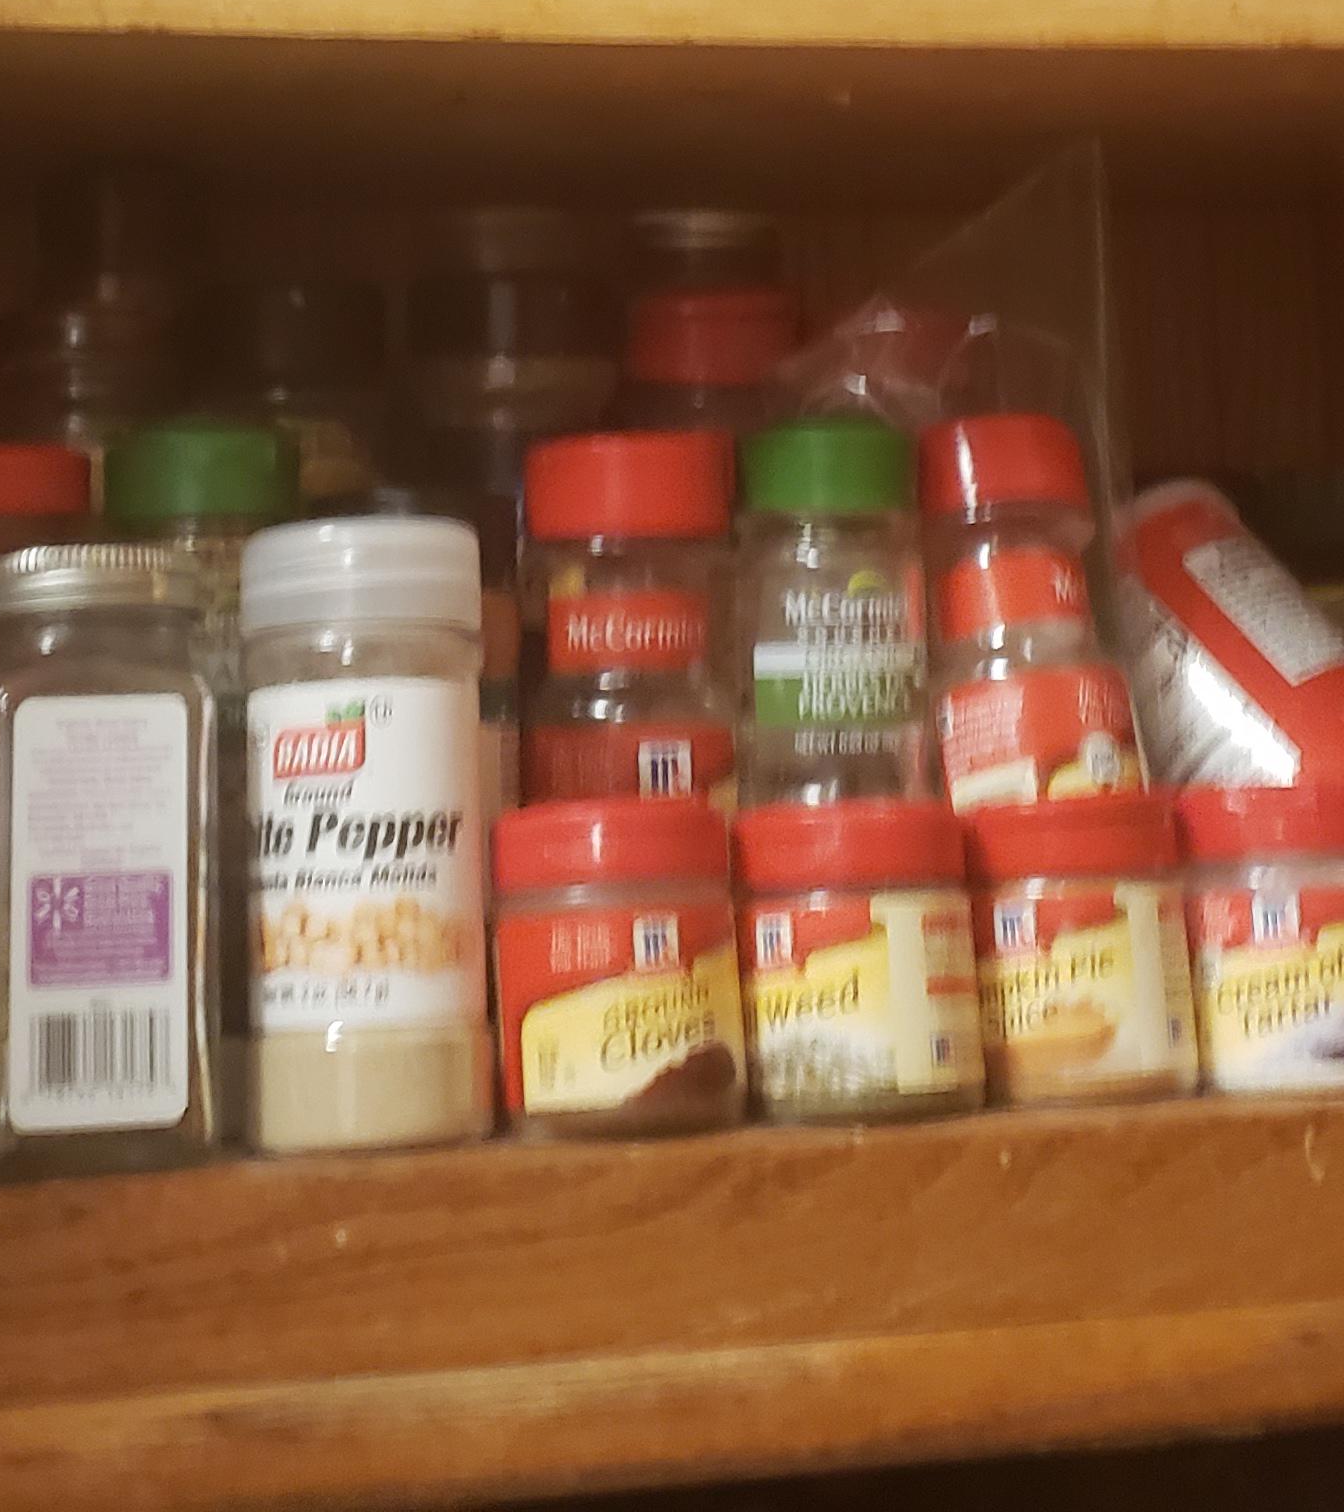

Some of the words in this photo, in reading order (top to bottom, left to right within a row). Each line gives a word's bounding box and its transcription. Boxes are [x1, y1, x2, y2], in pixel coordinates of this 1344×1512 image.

[306, 808, 463, 861] Pepper
[1070, 946, 1115, 984] Pie
[766, 968, 861, 1033] Weed
[600, 1010, 716, 1073] Cloves
